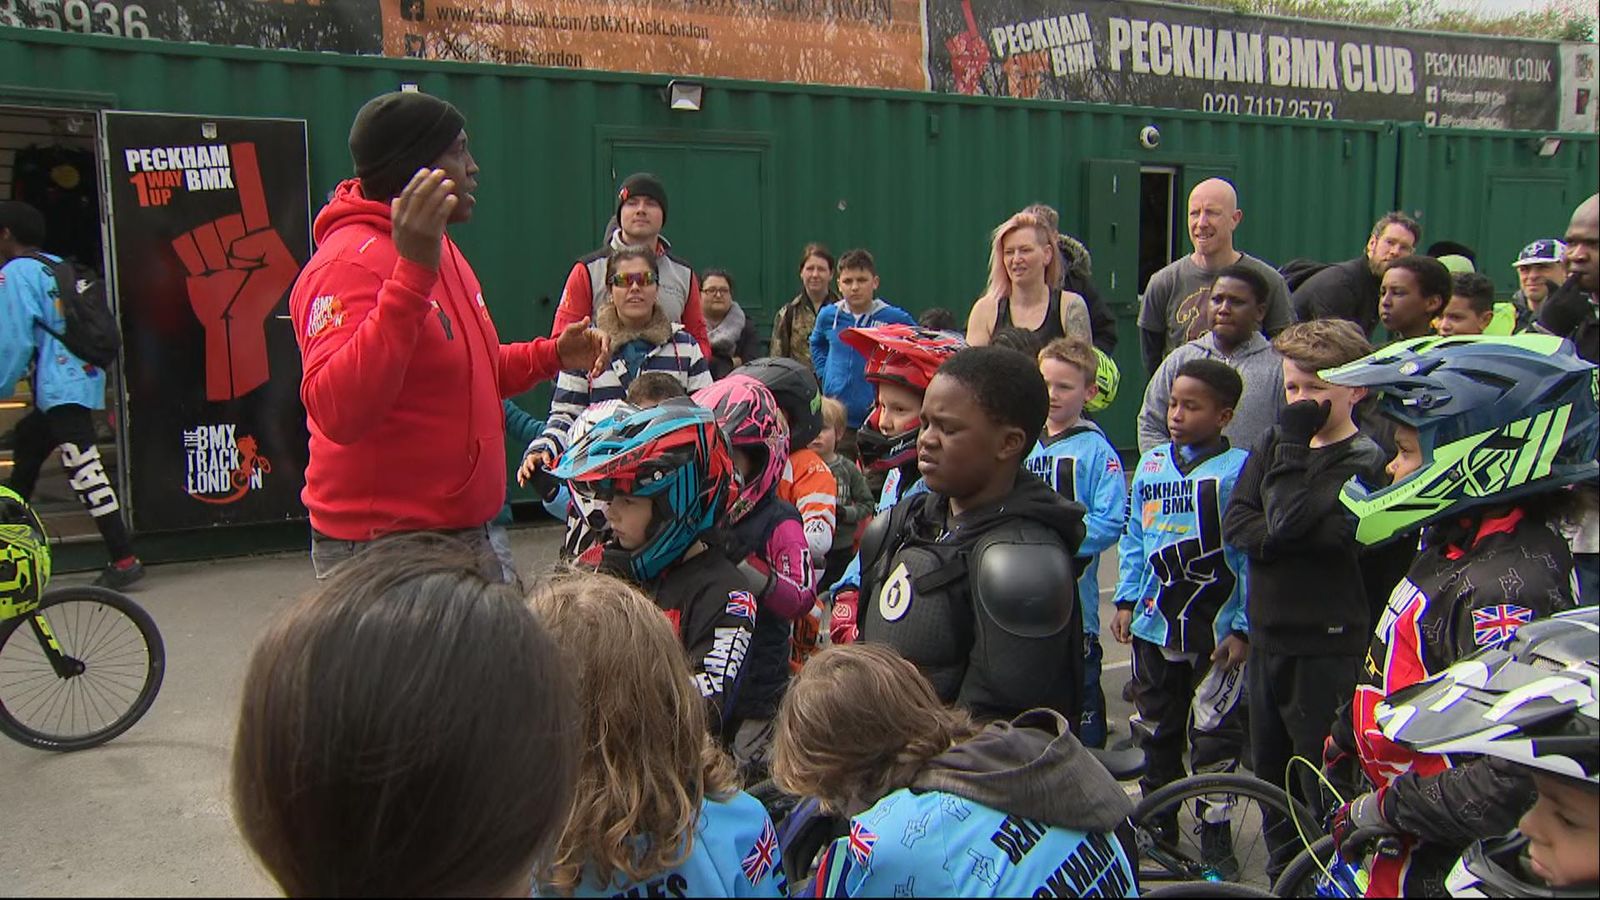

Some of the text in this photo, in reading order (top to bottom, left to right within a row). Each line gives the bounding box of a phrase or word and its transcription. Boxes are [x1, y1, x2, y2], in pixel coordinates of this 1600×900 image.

[991, 12, 1092, 58] PECKHAM
[1050, 40, 1098, 77] BMX
[1108, 17, 1264, 85] PECKHAM
[1268, 35, 1338, 90] BMX
[1340, 42, 1416, 95] CLUB
[1202, 92, 1334, 120] 020 7117 2573
[124, 144, 230, 172] PECKHAM
[129, 167, 235, 207] 1 WAY BMX
[149, 188, 172, 206] UP
[183, 429, 198, 447] THE
[196, 424, 237, 450] BMX
[187, 447, 240, 473] TRACK
[1162, 496, 1195, 516] BMX
